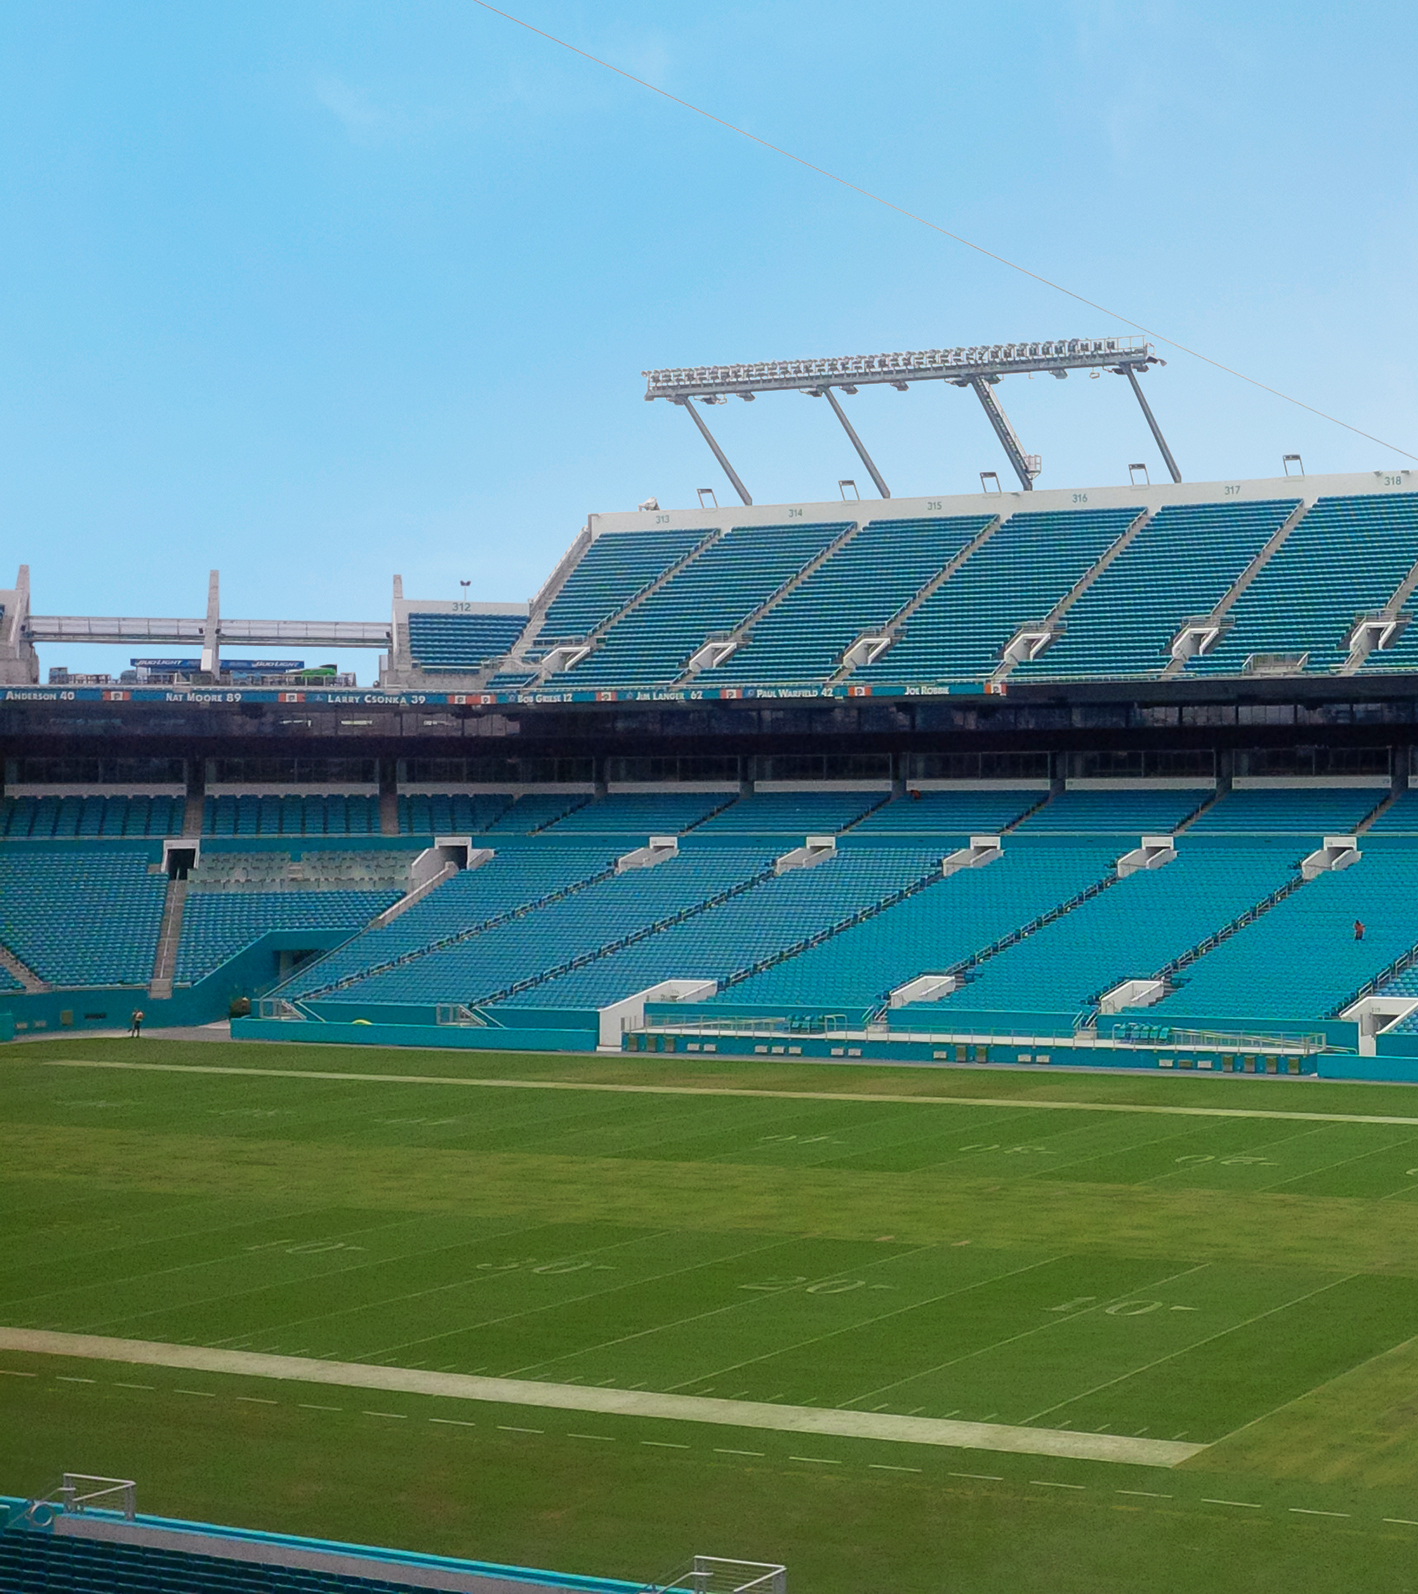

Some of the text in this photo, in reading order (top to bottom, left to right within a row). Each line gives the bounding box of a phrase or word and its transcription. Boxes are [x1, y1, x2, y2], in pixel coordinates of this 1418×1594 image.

[1384, 476, 1402, 486] 318
[1224, 486, 1240, 495] 317
[1072, 493, 1088, 503] 316
[927, 502, 942, 511] 315
[788, 509, 803, 518] 314
[655, 515, 670, 524] 313
[452, 603, 471, 611] 312
[690, 690, 703, 700] 62
[756, 687, 834, 698] PAUL WARFIELD 42
[904, 686, 920, 695] JOE
[6, 691, 75, 700] ANDERSON 40
[166, 692, 242, 702] NAT MOORE 89
[328, 694, 426, 704] LARRY CSONKA 39
[563, 693, 573, 702] 12
